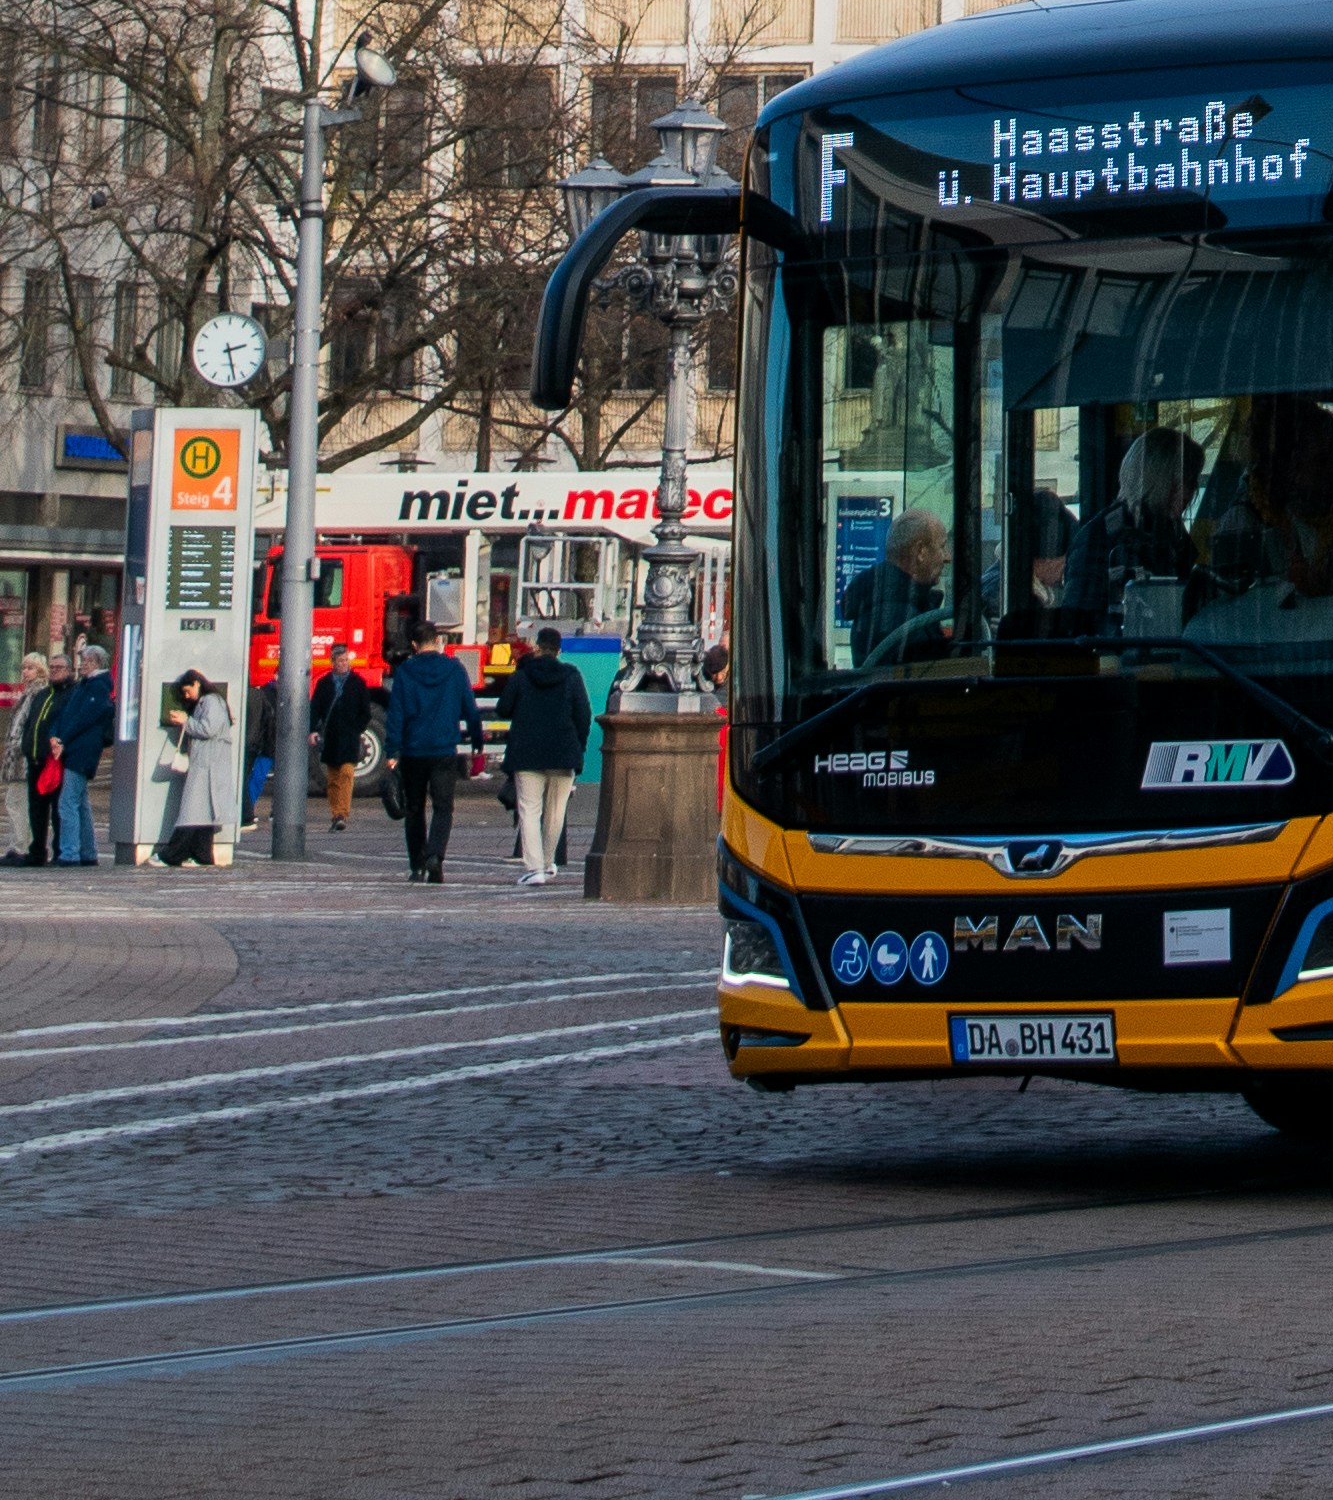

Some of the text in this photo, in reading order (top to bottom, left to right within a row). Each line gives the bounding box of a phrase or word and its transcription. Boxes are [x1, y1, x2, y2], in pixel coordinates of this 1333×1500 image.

[993, 100, 1255, 158] Haasstraße
[820, 131, 854, 223] F
[938, 138, 1310, 206] ü. Hauptbahnhof
[177, 476, 232, 508] Steig 4
[879, 498, 891, 517] 3
[1171, 743, 1279, 783] RMV
[953, 913, 1103, 951] MAN
[968, 1021, 1111, 1055] DA BH 431
